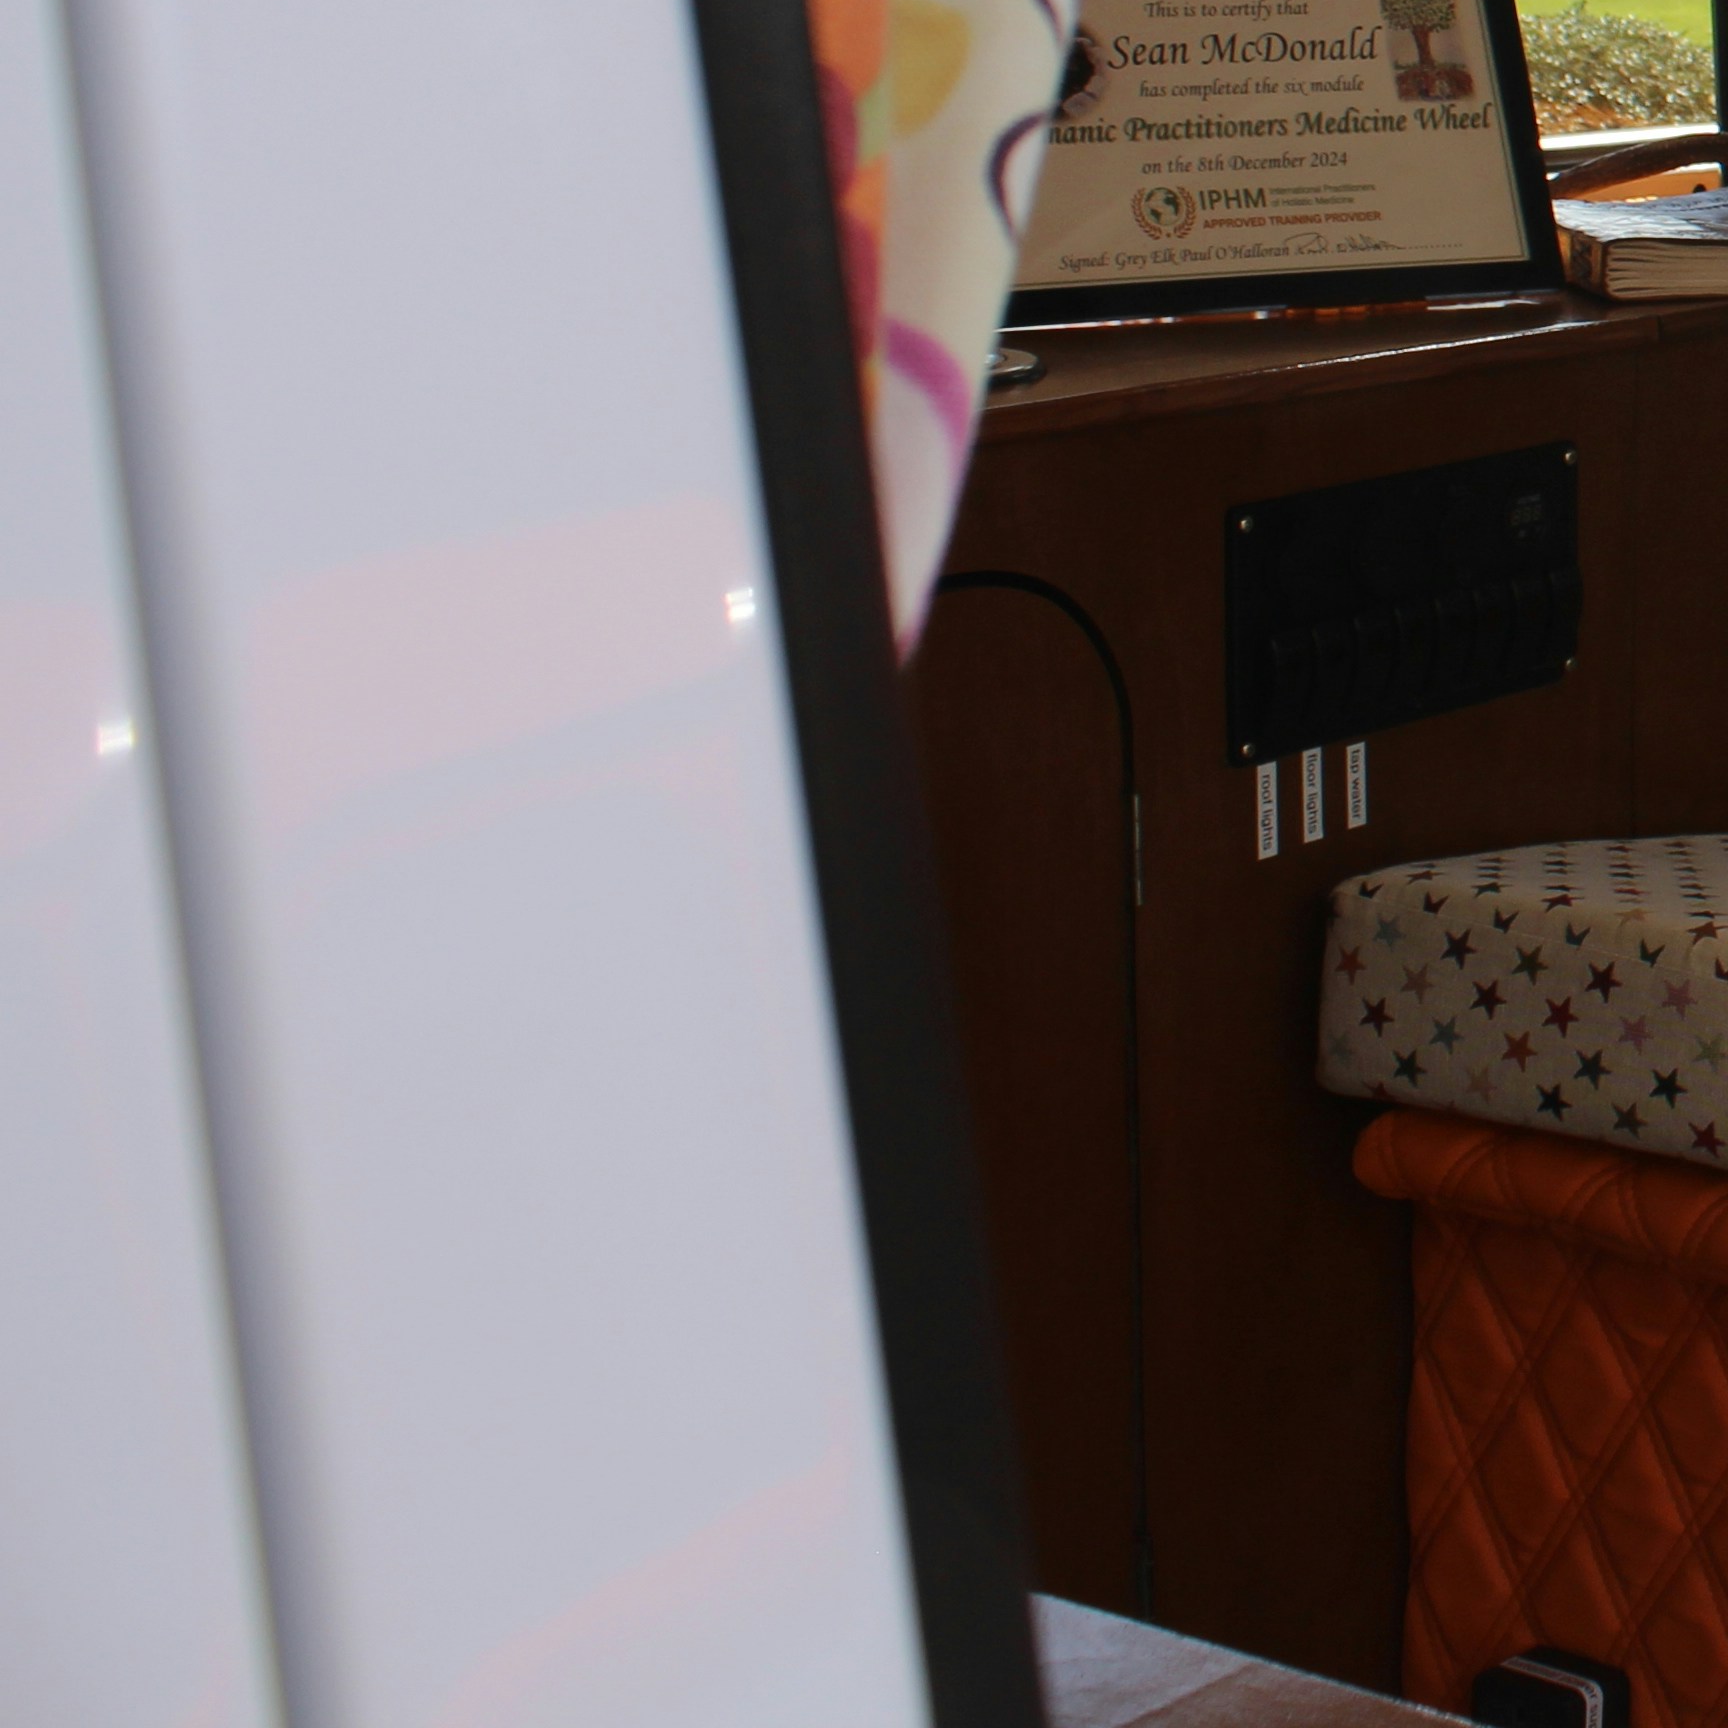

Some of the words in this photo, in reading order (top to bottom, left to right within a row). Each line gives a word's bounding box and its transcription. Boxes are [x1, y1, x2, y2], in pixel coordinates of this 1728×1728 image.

[1143, 1, 1179, 18] This
[1182, 2, 1197, 18] is
[1199, 2, 1218, 17] to
[1221, 0, 1274, 22] certify
[1276, 0, 1310, 16] that
[1107, 34, 1189, 70] Sean
[1200, 24, 1383, 65] McDonald
[1139, 80, 1168, 98] has
[1170, 77, 1250, 101] completed
[1254, 77, 1280, 94] the
[1283, 78, 1310, 98] six
[1310, 75, 1365, 93] module
[1124, 113, 1289, 143] Practitioners
[1296, 109, 1408, 136] Medicine
[1414, 101, 1493, 131] Wheel
[1141, 160, 1162, 174] on
[1164, 155, 1193, 173] the
[1198, 154, 1225, 172] 8th
[1226, 151, 1306, 172] December
[1309, 150, 1348, 168] 2024
[1199, 186, 1267, 211] IPHM
[1203, 215, 1267, 230] APPROVED
[1268, 213, 1322, 227] TRAINING
[1324, 210, 1383, 224] PROVIDER
[1058, 252, 1110, 272] Signed:
[1113, 250, 1149, 271] Grey
[1151, 248, 1180, 266] Elk
[1180, 247, 1212, 264] Paul
[1214, 243, 1290, 261] O'Halloran
[1306, 753, 1318, 789] floor
[1349, 748, 1362, 774] tap
[1261, 773, 1273, 805] roof
[1351, 777, 1363, 820] water
[1306, 792, 1319, 835] lights
[1261, 808, 1275, 852] lights
